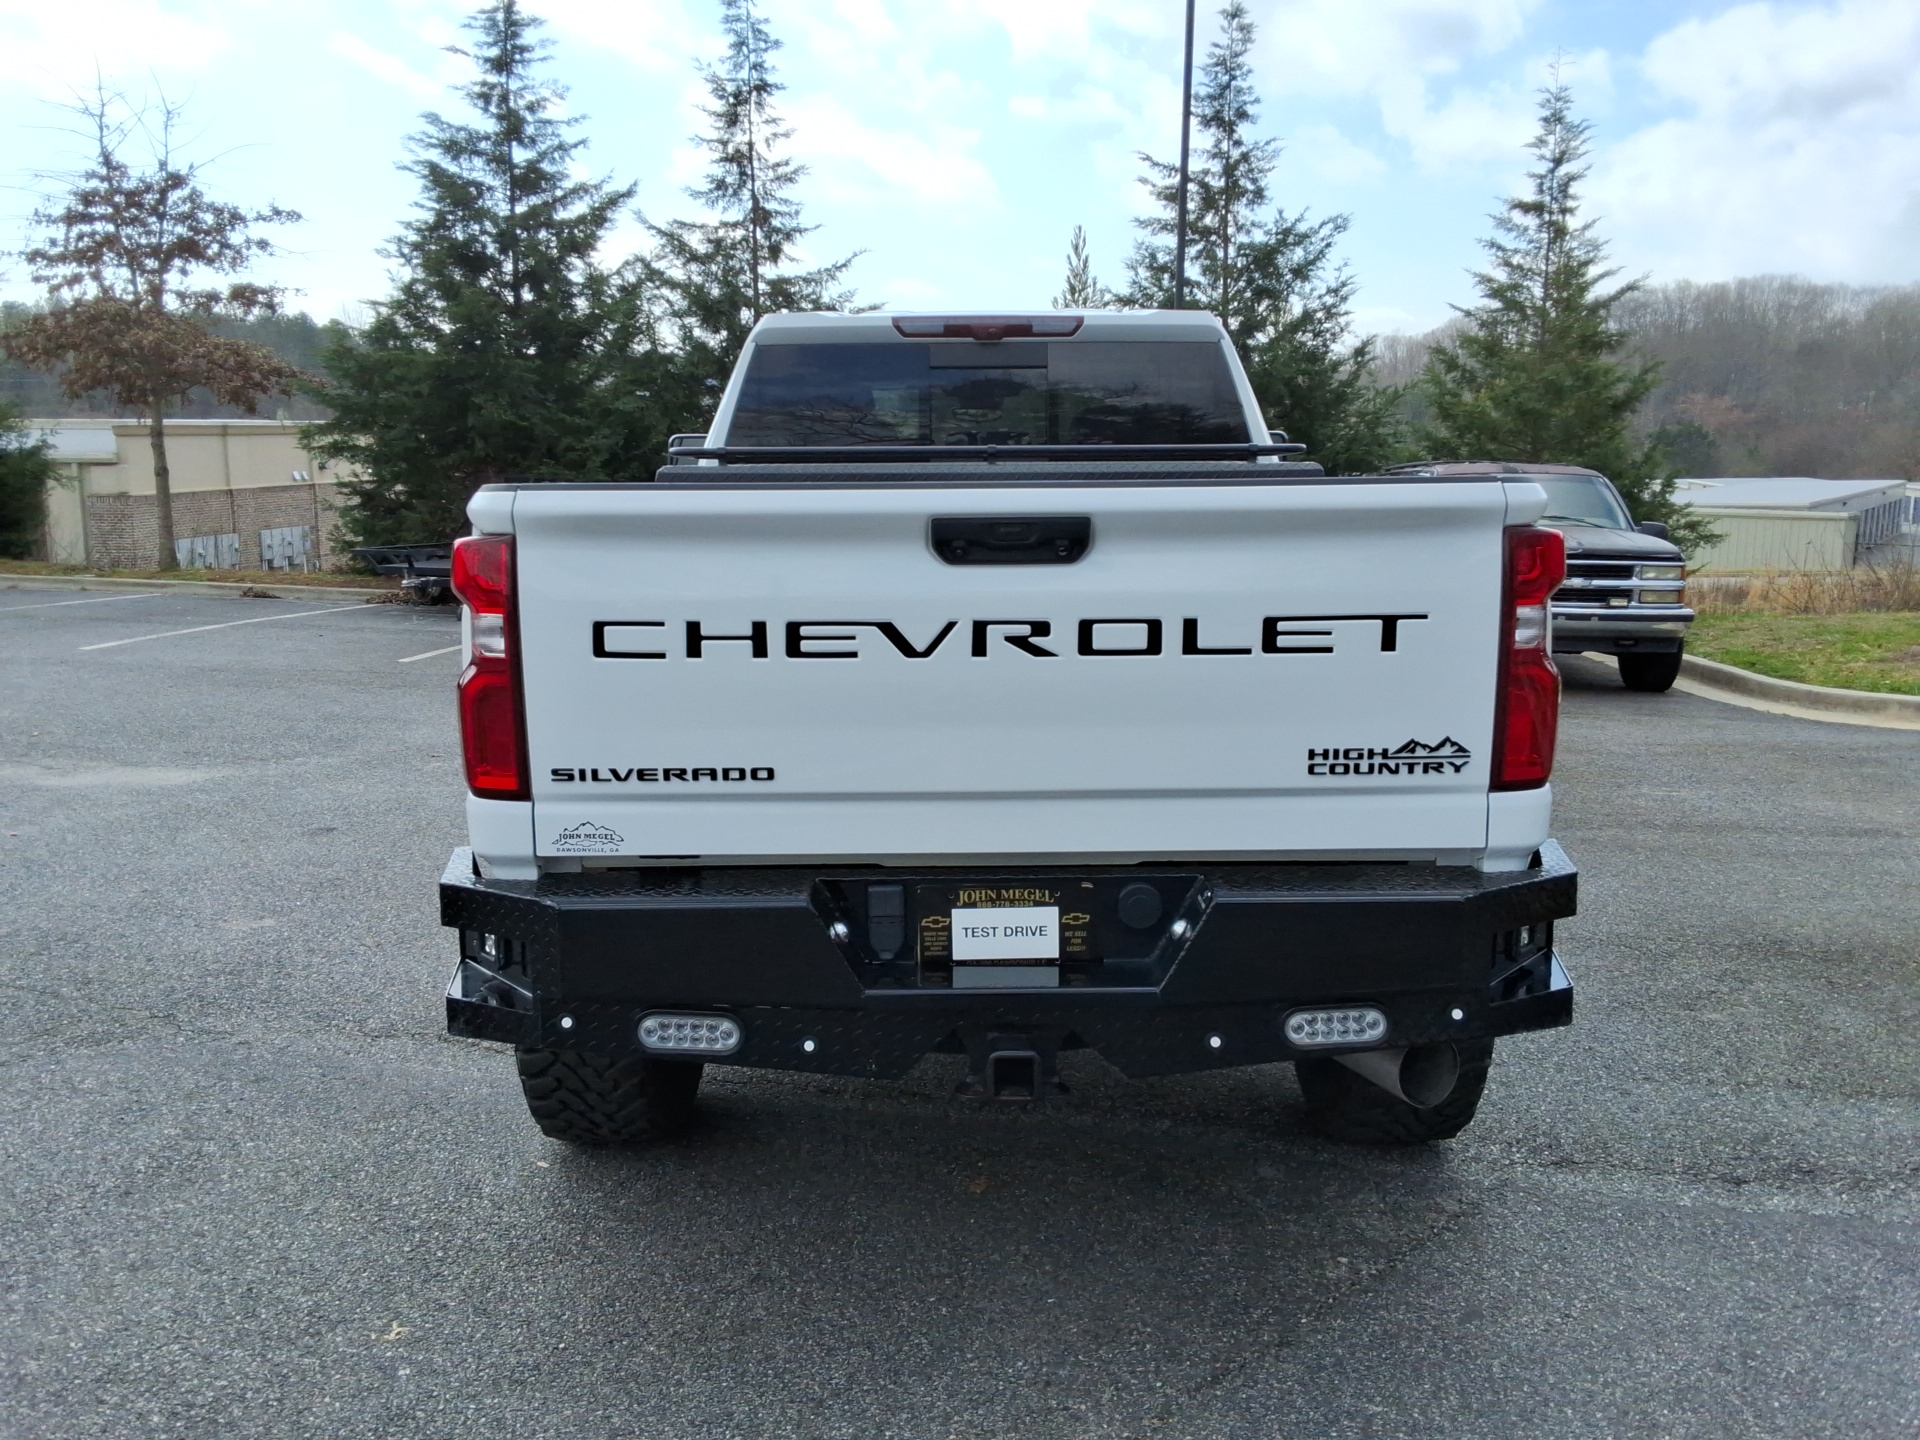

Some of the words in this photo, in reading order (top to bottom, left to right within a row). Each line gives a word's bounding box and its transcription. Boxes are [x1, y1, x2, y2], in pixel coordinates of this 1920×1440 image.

[592, 614, 1429, 659] CHEVROLET
[1308, 748, 1389, 760] HIGH
[550, 767, 775, 782] SILVERADO
[1308, 761, 1470, 775] COUNTRY
[559, 833, 582, 842] JOHN
[584, 833, 615, 841] MEGEL
[957, 890, 997, 907] JOHN
[1001, 889, 1055, 903] MEGEL
[962, 926, 999, 938] TEST
[1004, 925, 1048, 937] DRIVE
